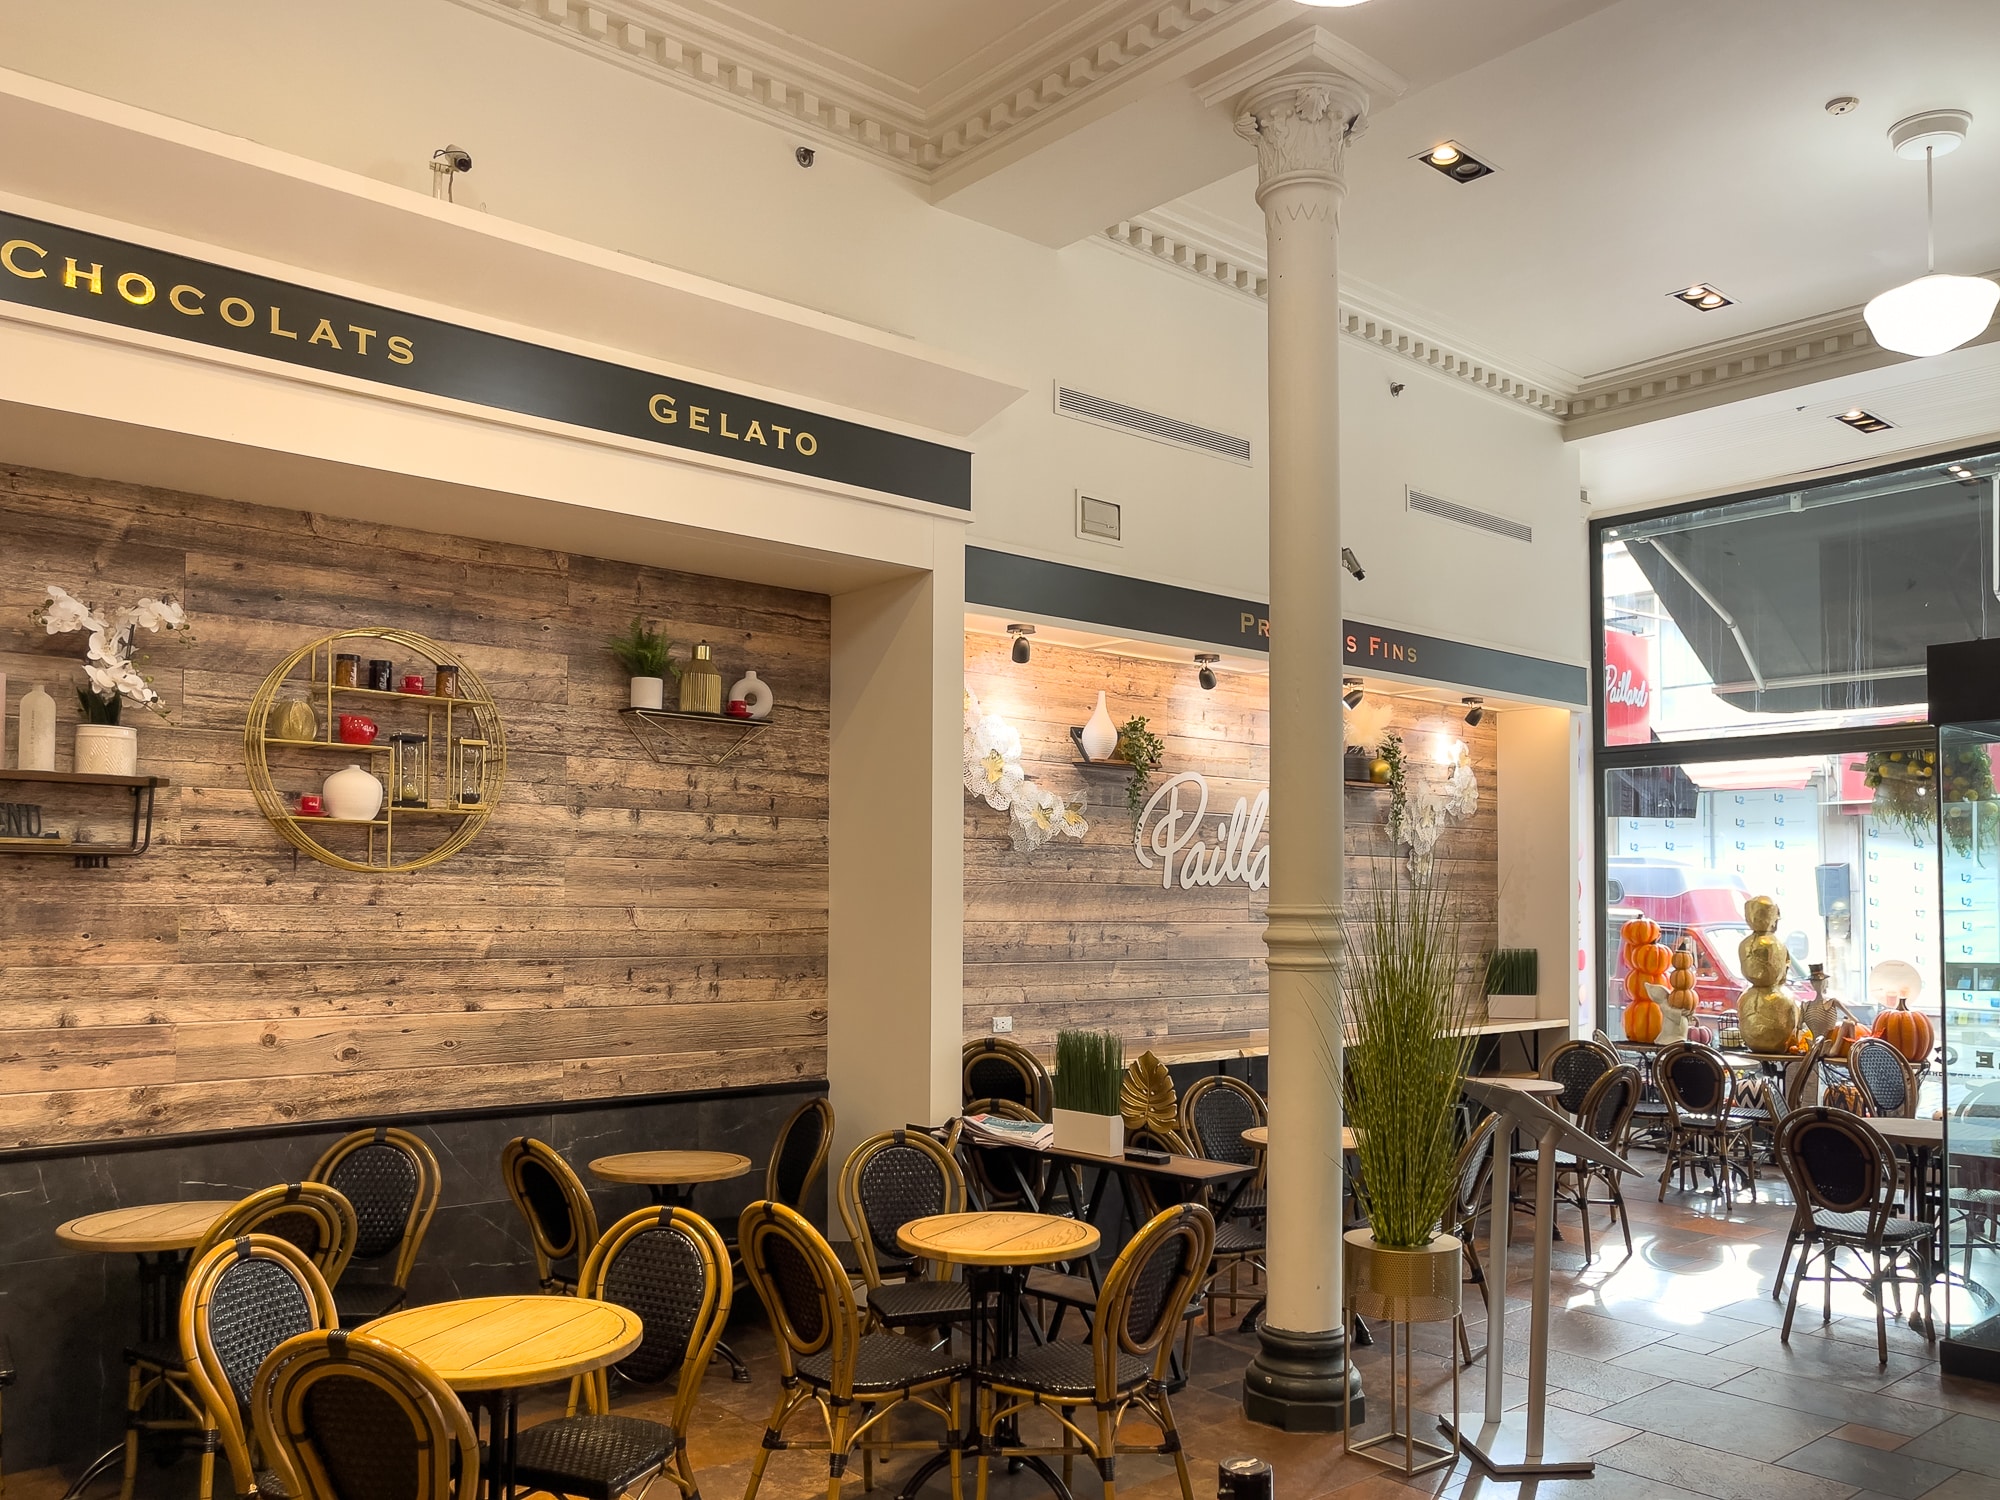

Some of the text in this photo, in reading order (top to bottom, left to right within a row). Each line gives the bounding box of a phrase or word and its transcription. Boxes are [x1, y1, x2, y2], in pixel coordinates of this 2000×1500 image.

[0, 239, 415, 365] CHOCOLATS
[648, 393, 818, 457] GELATO
[1369, 635, 1418, 663] FINS
[1134, 771, 1269, 891] Pailla
